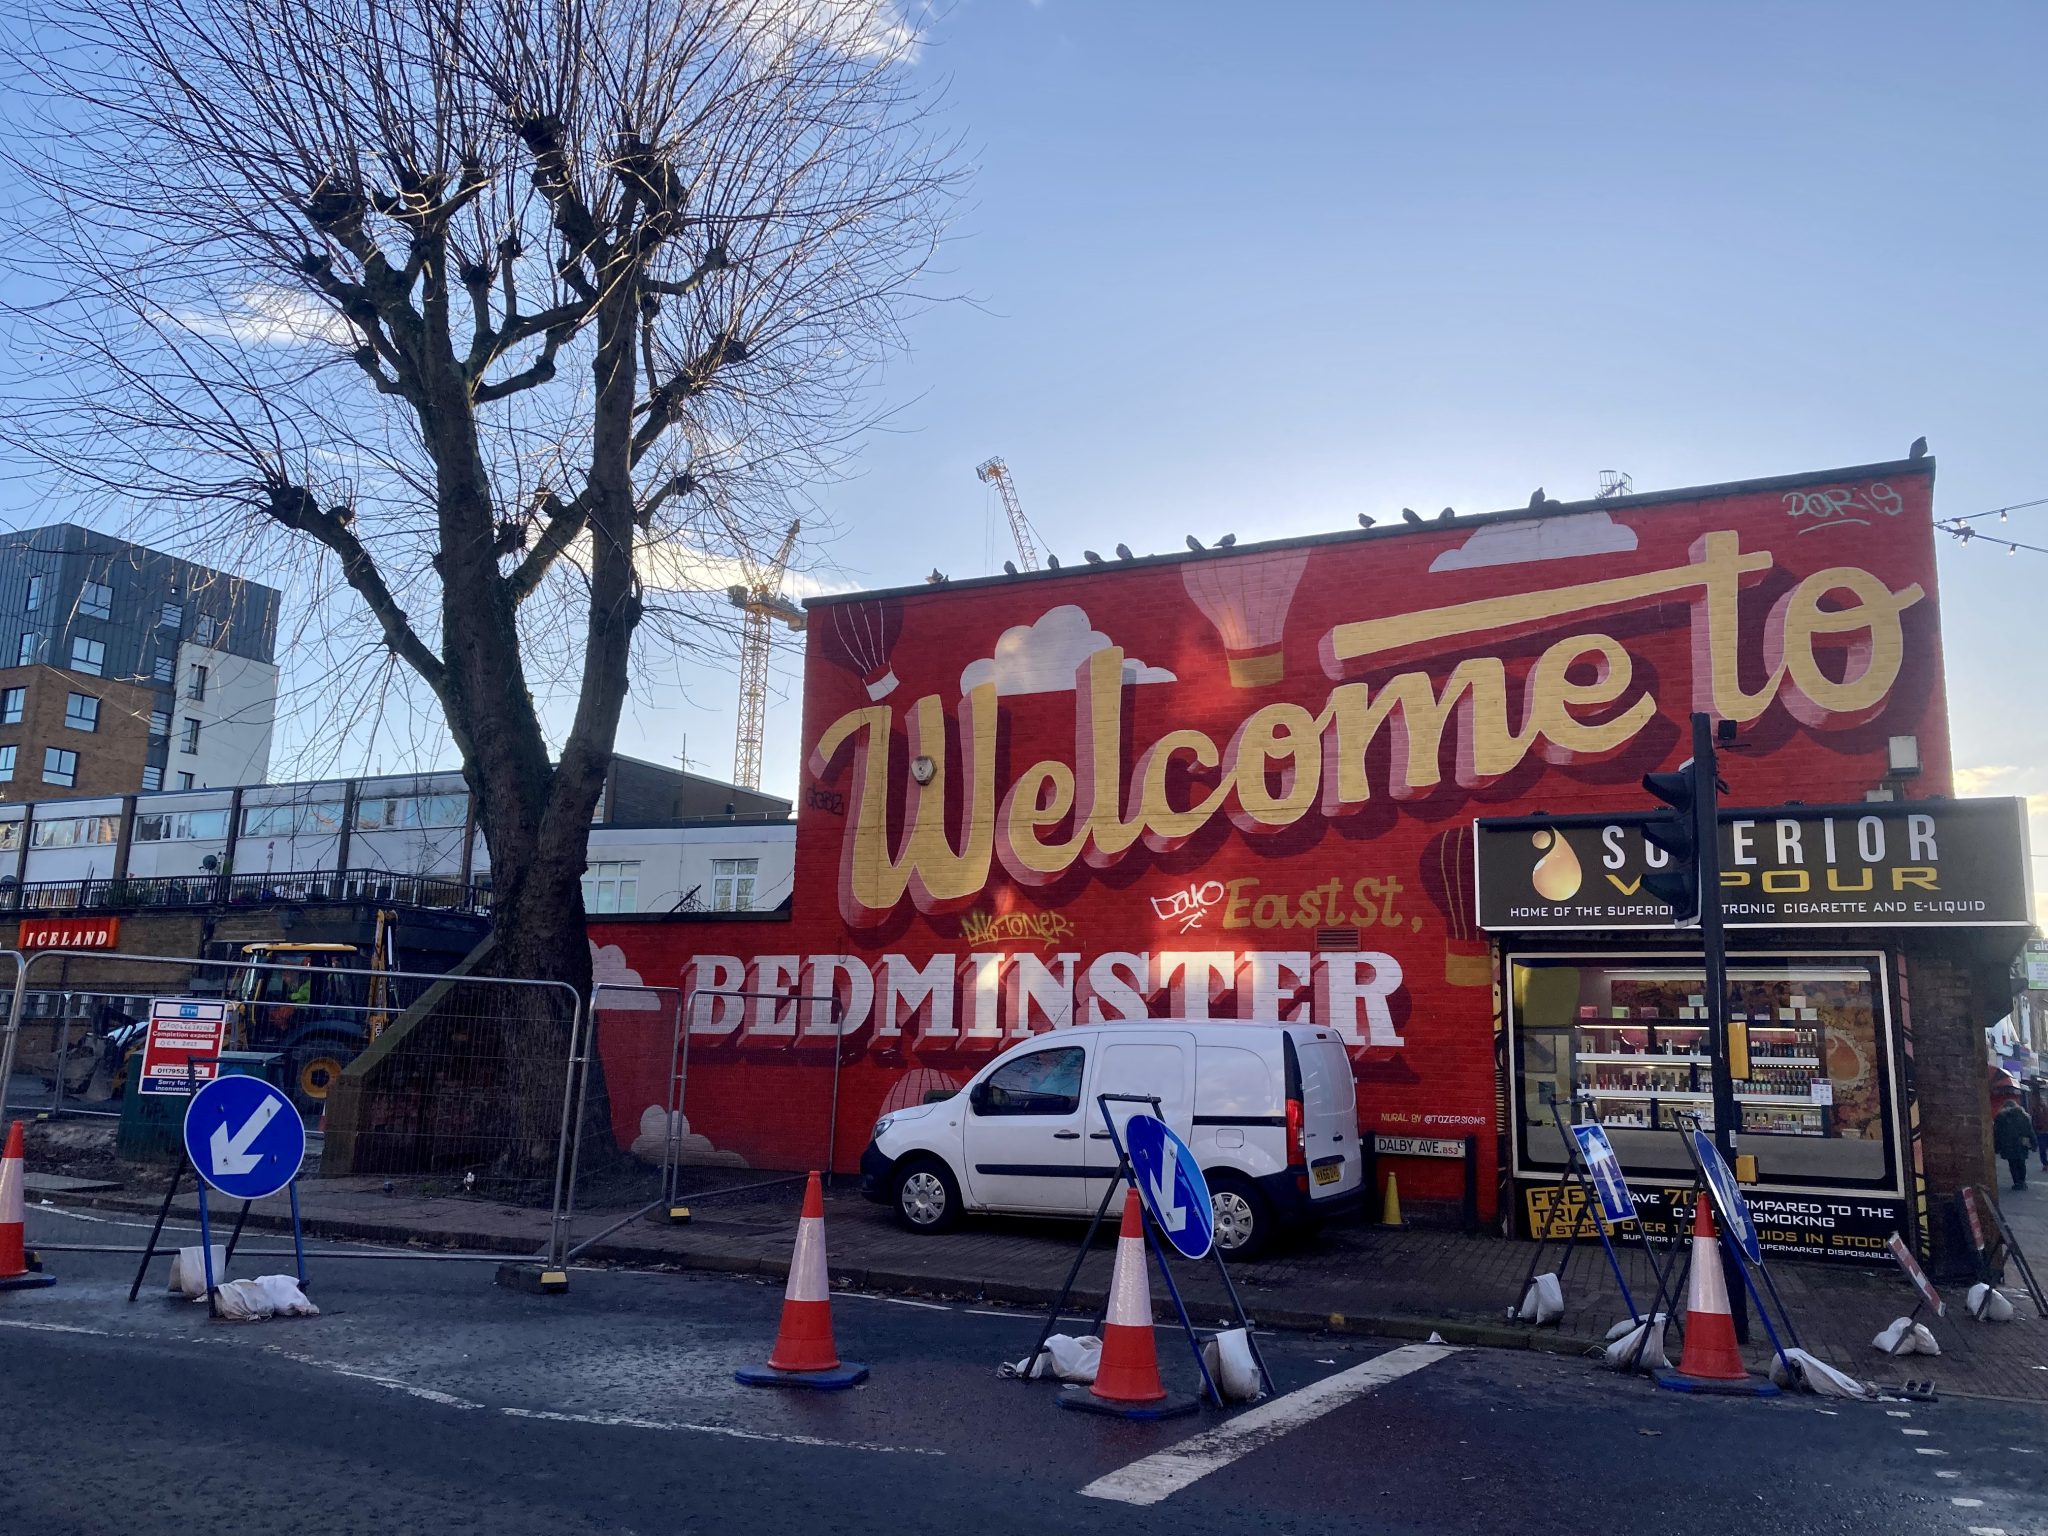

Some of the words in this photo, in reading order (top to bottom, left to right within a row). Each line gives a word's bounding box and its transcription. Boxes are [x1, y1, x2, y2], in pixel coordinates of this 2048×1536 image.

[816, 634, 1657, 909] Welcome
[1602, 814, 1938, 869] SUERIOR
[1604, 867, 1942, 896] VPOUR
[1222, 877, 1345, 929] East
[1510, 906, 1549, 917] HOME
[1554, 906, 1572, 917] OF
[1576, 905, 1601, 916] THE
[1607, 905, 1674, 916] SUPERIO
[1784, 901, 1867, 914] CIGARETTE
[1873, 901, 1907, 912] AND
[1914, 900, 1986, 914] E-LIQUID
[26, 930, 108, 947] ICELAND
[689, 951, 1405, 1047] BEDMINSTER
[181, 1007, 198, 1015] ETM
[158, 1079, 176, 1087] Sorry
[1381, 1113, 1409, 1122] MURAL
[1412, 1114, 1422, 1123] BY
[1424, 1114, 1486, 1125] @TOZERSIGNS
[1379, 1139, 1413, 1152] DALBY
[1631, 1193, 1660, 1205] AVE
[1827, 1204, 1851, 1216] TO
[1857, 1206, 1895, 1219] THE
[1753, 1212, 1835, 1228] SMOKING
[1622, 1234, 1669, 1243] SUPRIOR
[1759, 1244, 1824, 1255] UPERMARKET
[1805, 1232, 1824, 1245] IN
